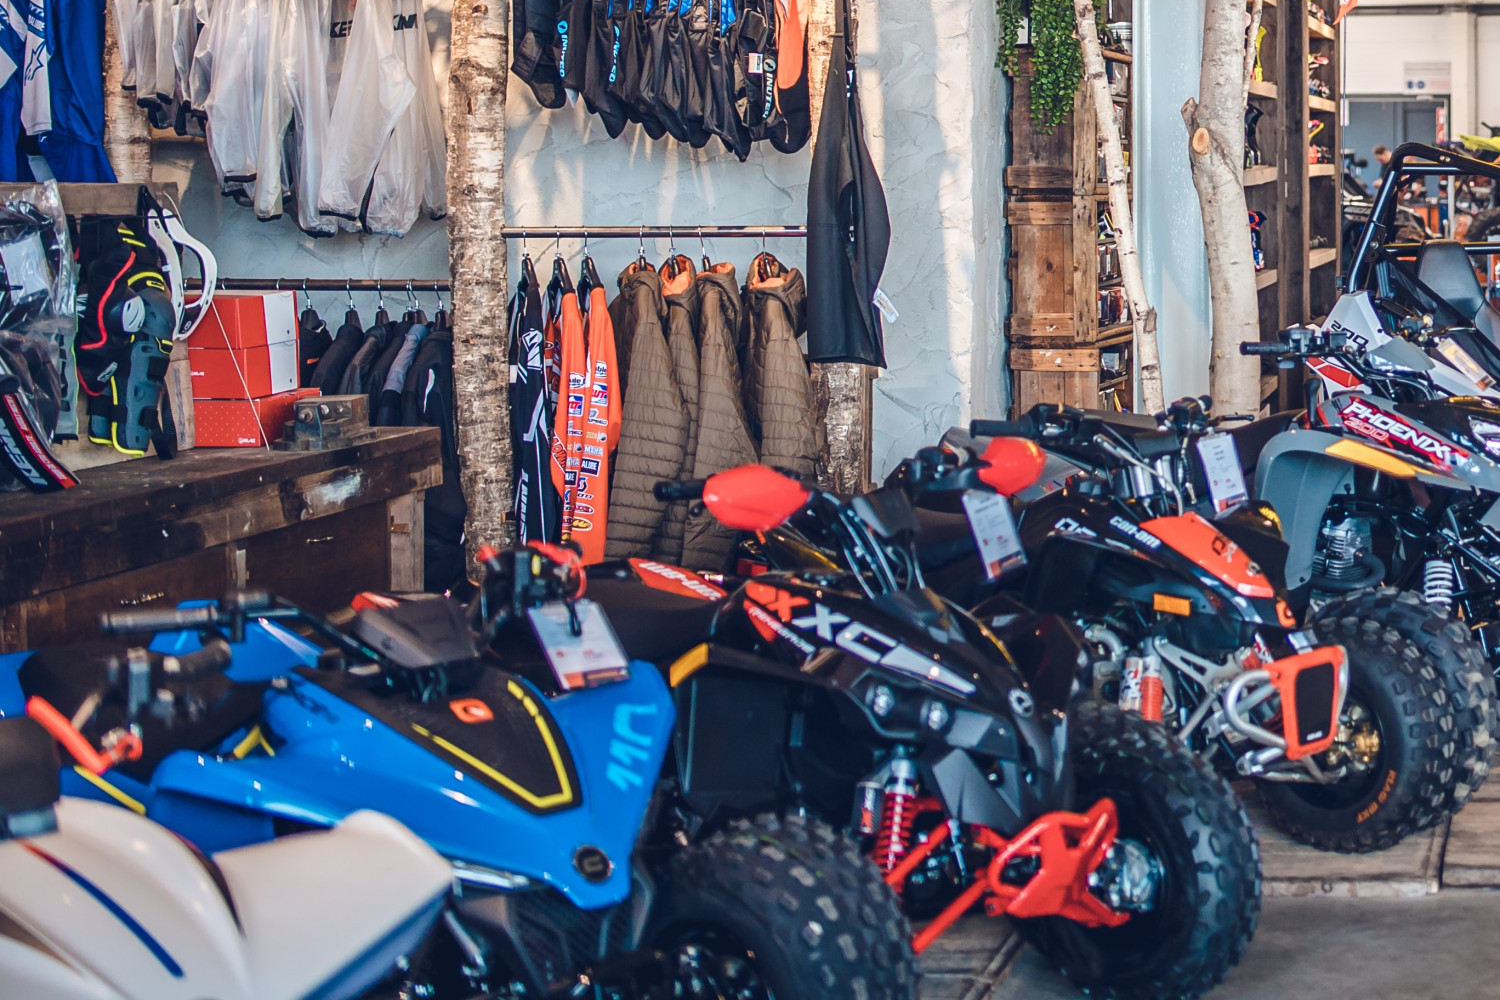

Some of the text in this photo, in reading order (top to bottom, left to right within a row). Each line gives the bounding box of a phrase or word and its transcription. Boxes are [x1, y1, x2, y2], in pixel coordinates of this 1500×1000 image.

[1343, 416, 1389, 441] 200
[1344, 400, 1454, 463] PHOENIX
[1109, 515, 1163, 550] can-am
